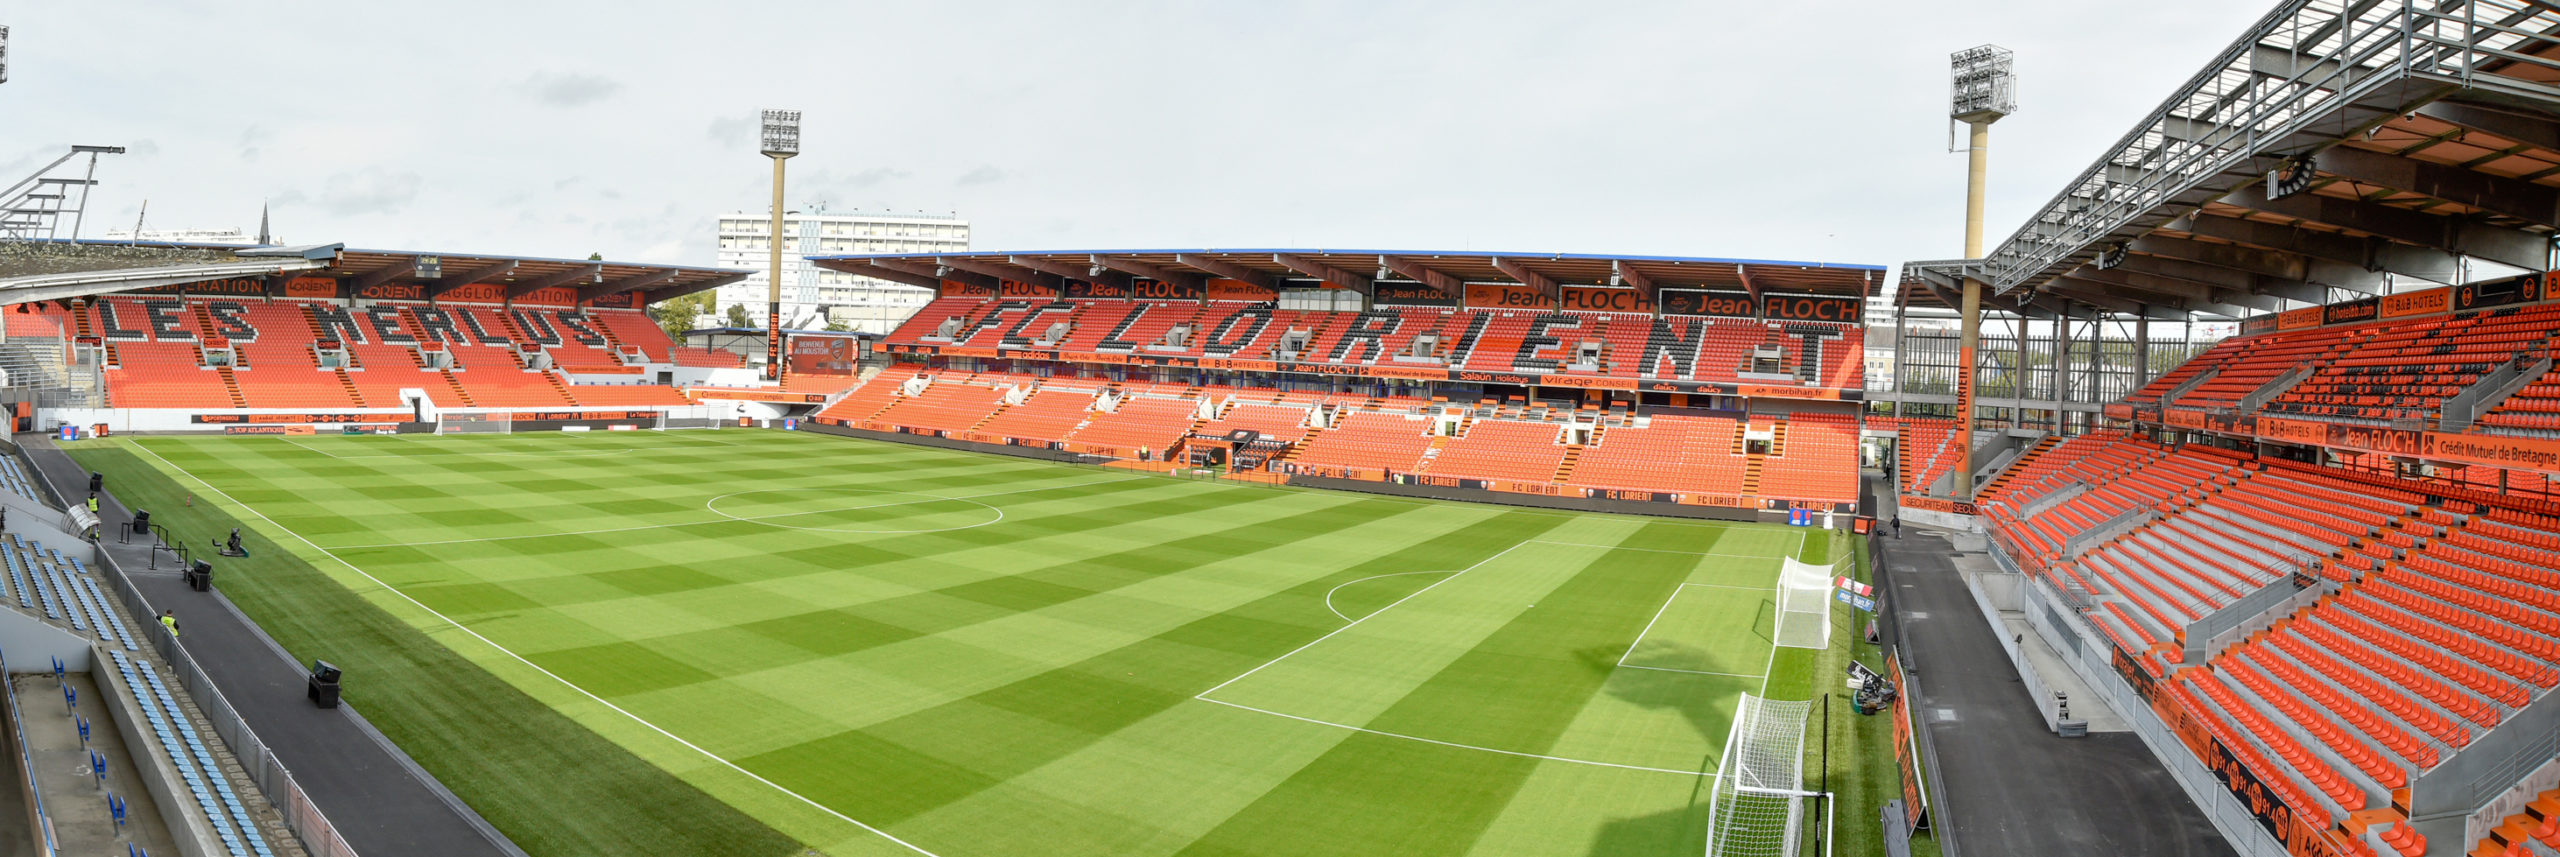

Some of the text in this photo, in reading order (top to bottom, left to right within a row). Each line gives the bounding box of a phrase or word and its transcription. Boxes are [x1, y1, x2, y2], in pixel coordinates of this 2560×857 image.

[290, 280, 333, 292] LORIENT
[361, 282, 425, 299] LORIENT
[1001, 280, 1056, 295] FLOC
[1135, 280, 1200, 298] FLOC
[1246, 286, 1277, 295] FLOC
[1392, 289, 1416, 298] Jean
[1418, 289, 1457, 299] FLOC
[1498, 288, 1549, 307] Jean
[1564, 289, 1651, 310] FLOC'H
[1697, 295, 1751, 315] Jean
[1765, 298, 1858, 321] FLOC'H
[2395, 294, 2444, 312] B&B HOTELS
[98, 299, 260, 343] LES
[2287, 311, 2320, 325] B&B HOTELS
[309, 303, 609, 349] MERLUS
[770, 313, 779, 345] LORIENT
[952, 301, 1843, 386] FC LORIENT
[1021, 351, 1050, 359] adidas
[1214, 360, 1259, 369] B&B HOTELS
[1294, 364, 1355, 375] Jean FLOC'H
[1421, 371, 1446, 379] Bretagne
[1460, 371, 1529, 384] Salaün Holidays
[1596, 379, 1633, 388] CONSEIL
[1771, 388, 1822, 397] morbihan.fr
[1957, 365, 1969, 431] FC LORIENT
[2270, 420, 2285, 437] B&B
[2286, 423, 2310, 438] HOTELS
[2344, 428, 2416, 453] Jean FLOC'H
[2440, 439, 2557, 467] Crédit Mutuel de Bretagne
[1333, 469, 1361, 479] LOENT
[1420, 476, 1459, 487] FC LORIENT
[1512, 483, 1559, 494] FC LORIENT
[1606, 490, 1652, 501] FC LORIENT
[1697, 495, 1743, 506] FC LORIENT
[1789, 501, 1800, 510] FC
[1906, 497, 1952, 511] SECURITEAM
[1839, 593, 1871, 608] morihan.fr
[2219, 754, 2230, 777] 91.4
[2239, 775, 2251, 799] 91.4
[2262, 798, 2276, 823] 91.4
[2278, 812, 2287, 827] hit
